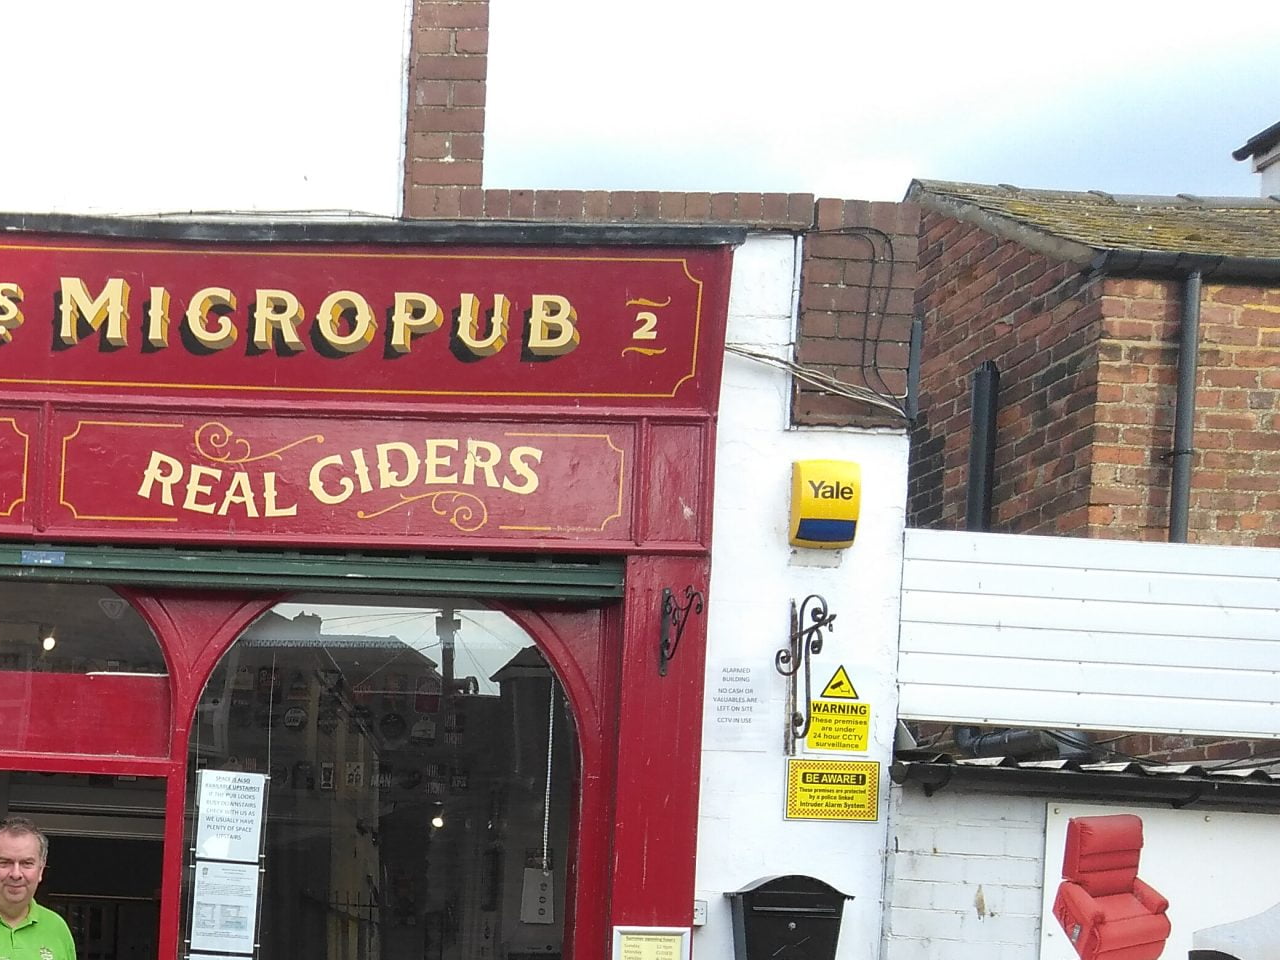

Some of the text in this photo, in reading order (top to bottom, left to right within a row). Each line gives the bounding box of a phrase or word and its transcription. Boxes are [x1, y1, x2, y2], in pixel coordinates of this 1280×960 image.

[52, 277, 579, 360] MICROPUB
[632, 312, 658, 339] 2
[137, 438, 543, 518] REAL CIDERS
[808, 480, 854, 500] Yale
[812, 702, 867, 715] WARNING
[811, 716, 868, 726] These premises
[834, 725, 856, 733] under
[815, 741, 860, 749] surveillance
[805, 773, 820, 783] BE
[821, 774, 857, 784] AWARE
